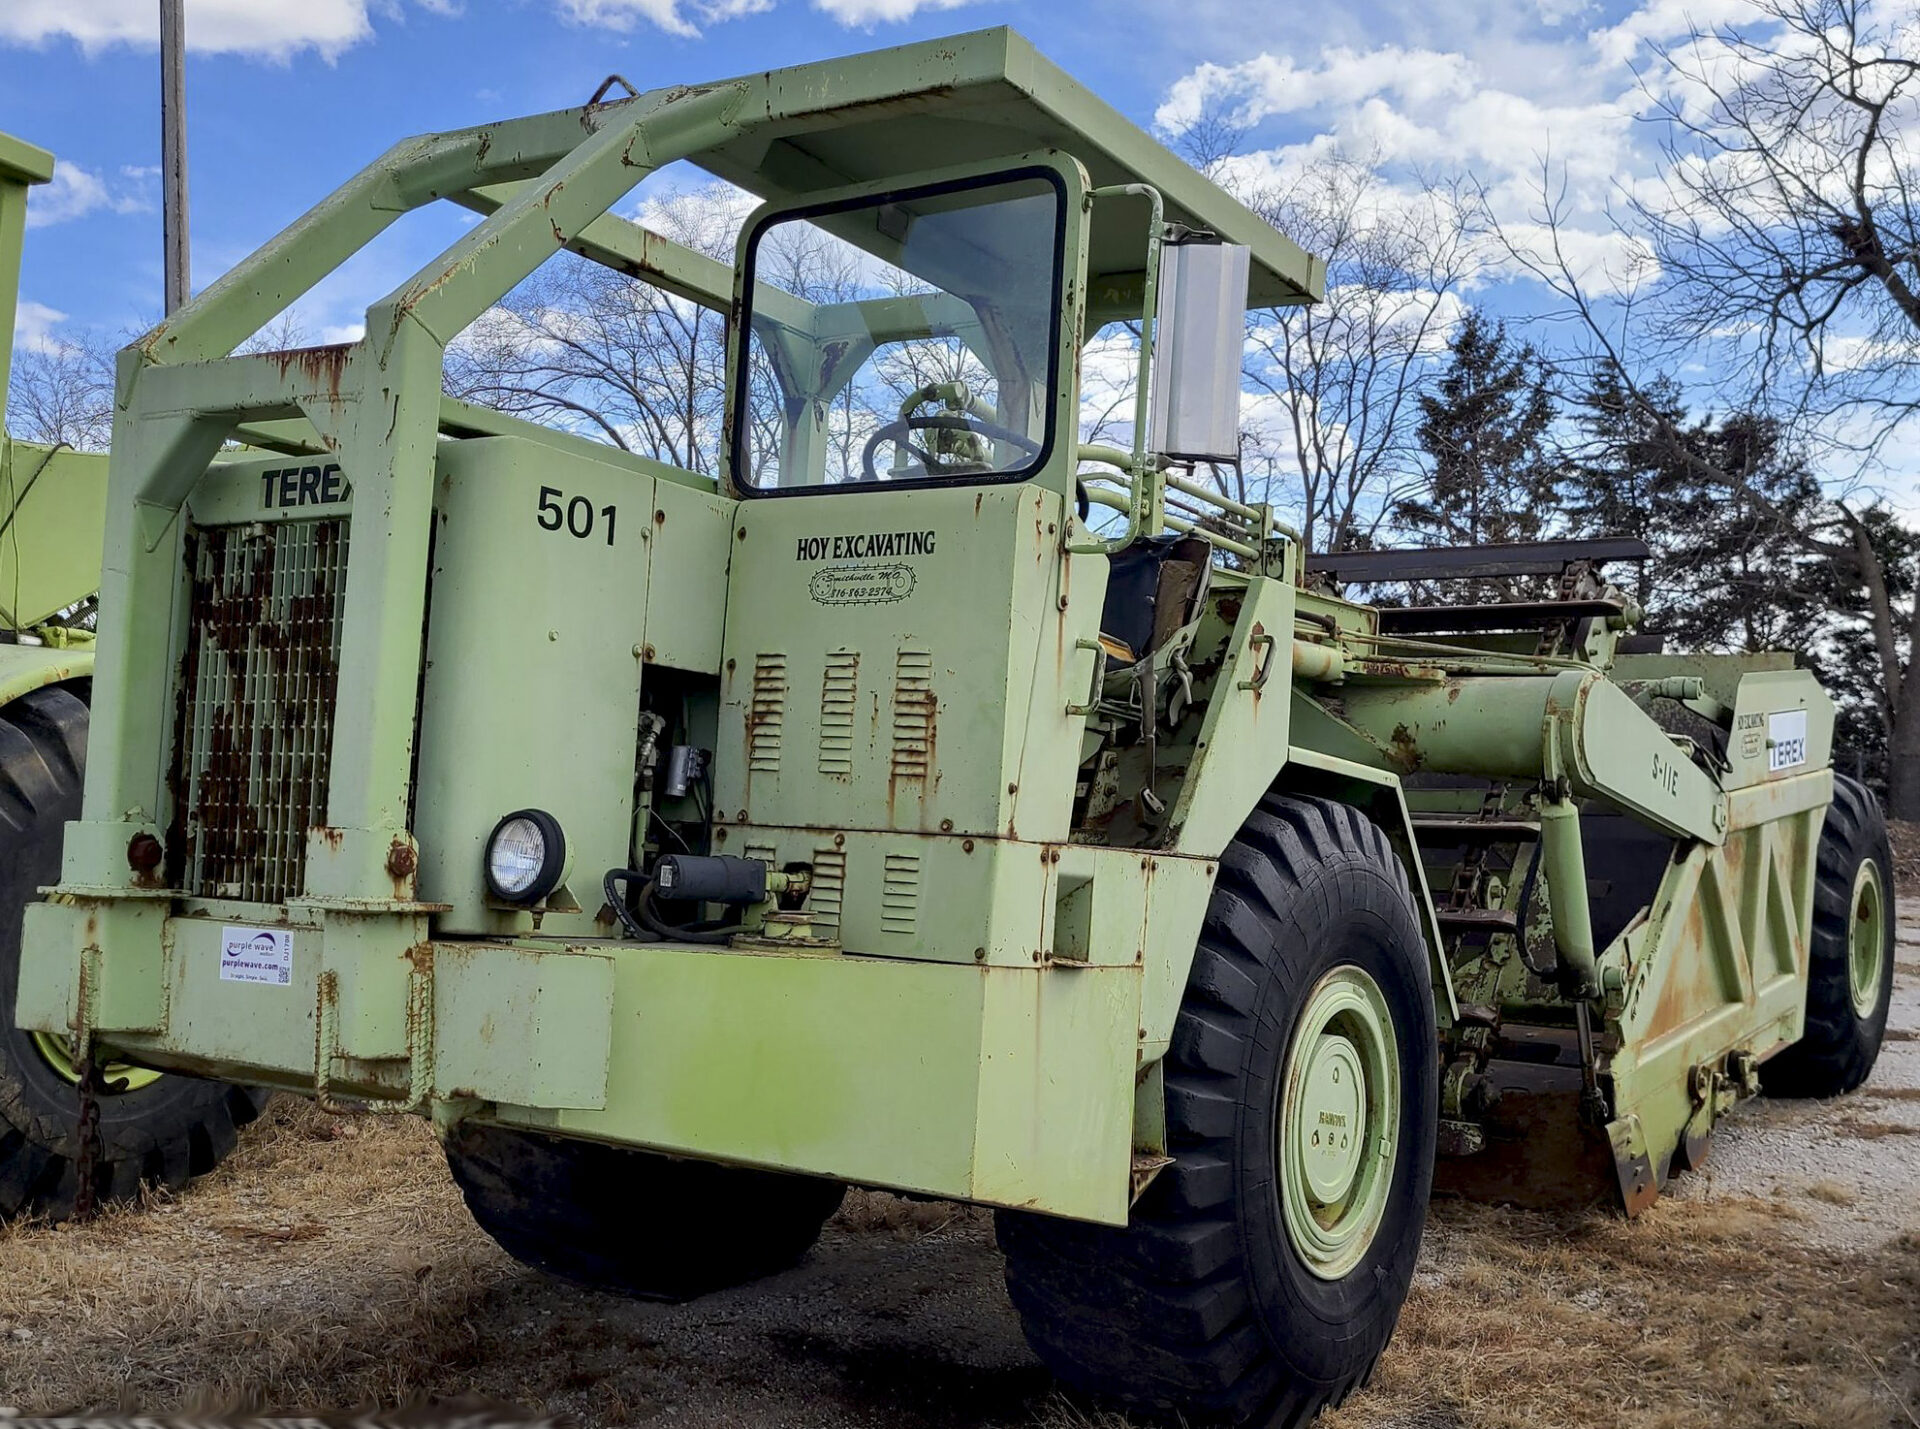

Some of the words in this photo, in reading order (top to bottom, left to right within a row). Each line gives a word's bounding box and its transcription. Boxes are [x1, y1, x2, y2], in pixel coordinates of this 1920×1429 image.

[537, 485, 616, 546] 501
[796, 537, 830, 561] HOY
[832, 530, 936, 559] EXCAVATING
[825, 573, 875, 583] Smithville
[1772, 737, 1804, 767] TEREX
[228, 941, 252, 951] purple
[254, 943, 274, 952] wave
[222, 959, 278, 970] purplewave.com
